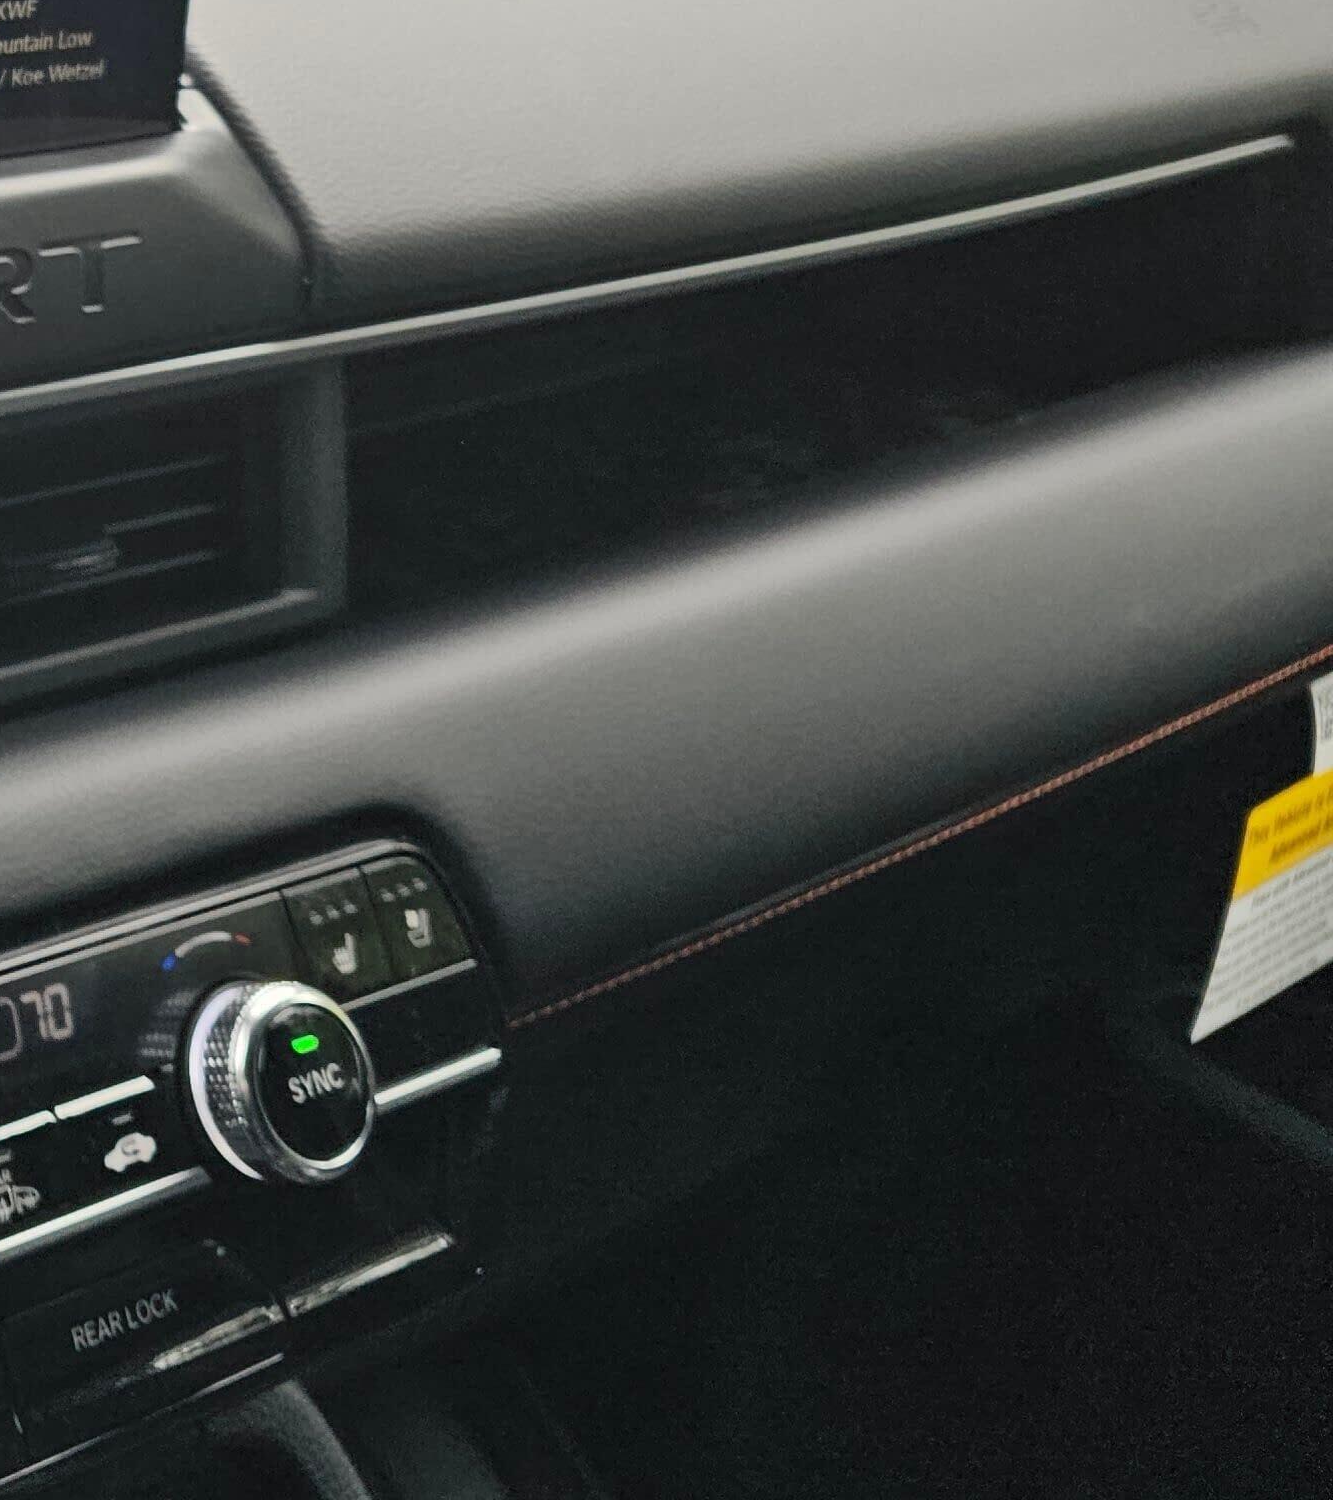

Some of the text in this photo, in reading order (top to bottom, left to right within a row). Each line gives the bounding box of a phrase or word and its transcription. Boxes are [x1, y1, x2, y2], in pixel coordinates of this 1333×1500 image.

[58, 28, 93, 50] Low
[19, 982, 73, 1040] 70
[288, 1062, 345, 1104] SYNC
[71, 1289, 179, 1352] REAR LOCK
